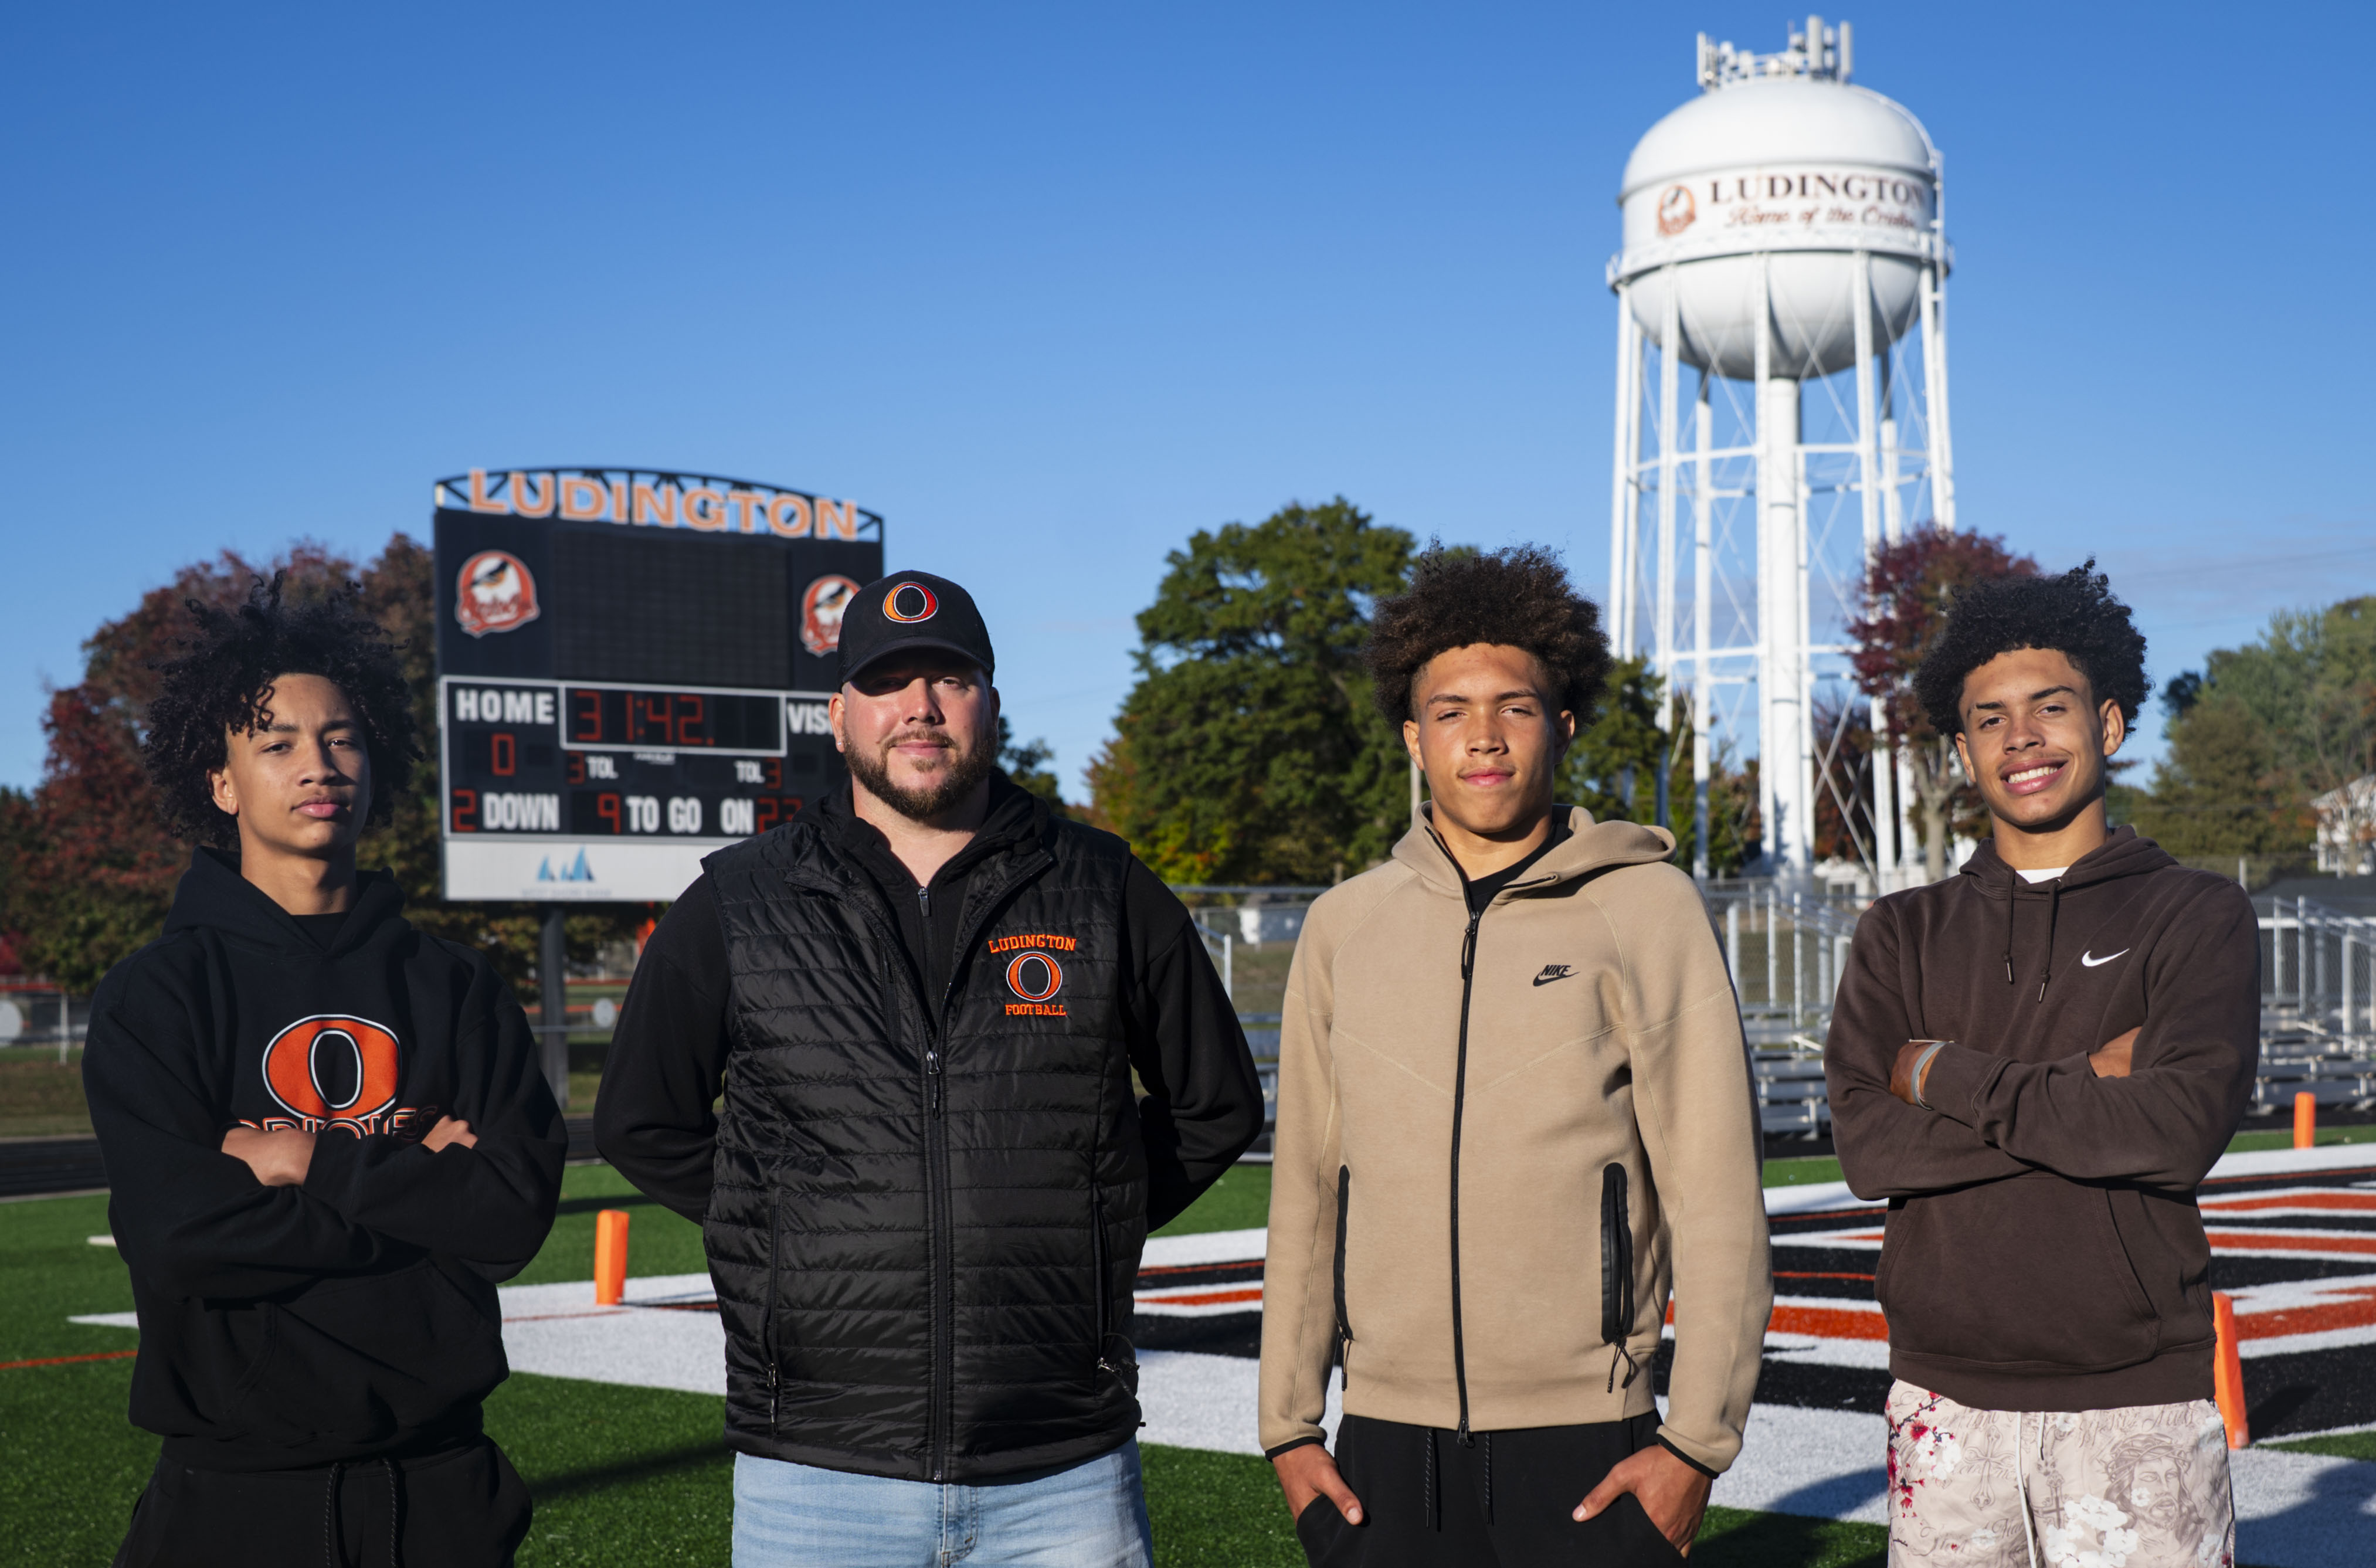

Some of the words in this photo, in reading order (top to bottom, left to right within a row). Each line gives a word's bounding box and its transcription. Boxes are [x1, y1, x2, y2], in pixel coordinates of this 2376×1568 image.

[1710, 175, 1924, 209] LUDINGTON
[1727, 205, 1790, 226] Home
[1798, 207, 1820, 229] of
[1825, 206, 1854, 223] the
[470, 469, 858, 540] LUDINGTON
[882, 581, 938, 623] O
[456, 689, 555, 724] HOME
[787, 703, 833, 735] VIS
[491, 734, 515, 776] 0
[567, 751, 585, 784] 3
[765, 757, 782, 789] 3
[453, 789, 476, 831] 2
[483, 792, 560, 830] DOWN
[598, 794, 620, 834] 9
[625, 796, 660, 833] TO
[667, 796, 702, 834] GO
[720, 798, 754, 835] ON
[988, 934, 1077, 953] LUDINGTON
[1006, 951, 1063, 1002] O
[1540, 965, 1571, 977] NIKE
[1005, 1004, 1067, 1016] FOOTBALL
[262, 1014, 402, 1124] O
